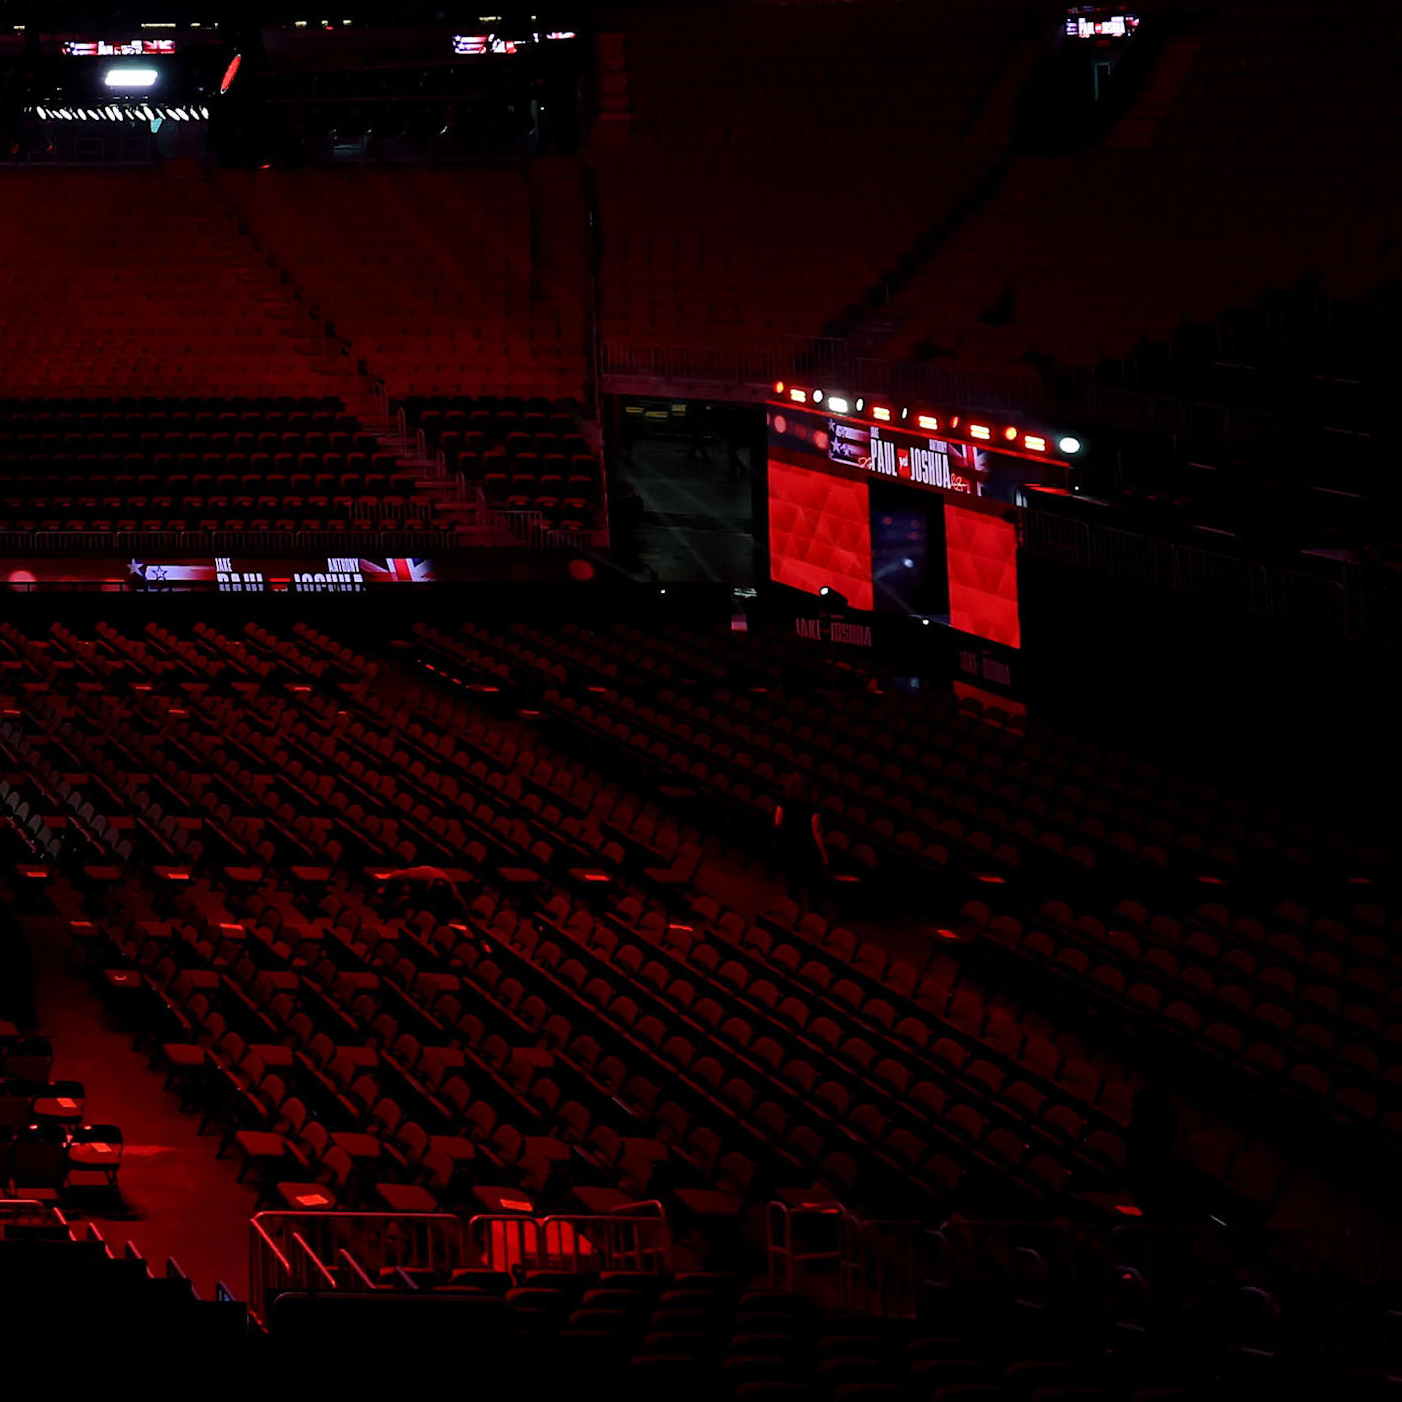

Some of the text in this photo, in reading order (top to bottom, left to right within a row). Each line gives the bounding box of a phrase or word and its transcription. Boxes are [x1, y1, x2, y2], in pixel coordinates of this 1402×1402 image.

[870, 438, 898, 476] PAUL
[909, 447, 952, 489] JOSHUA
[214, 557, 233, 572] JAKE
